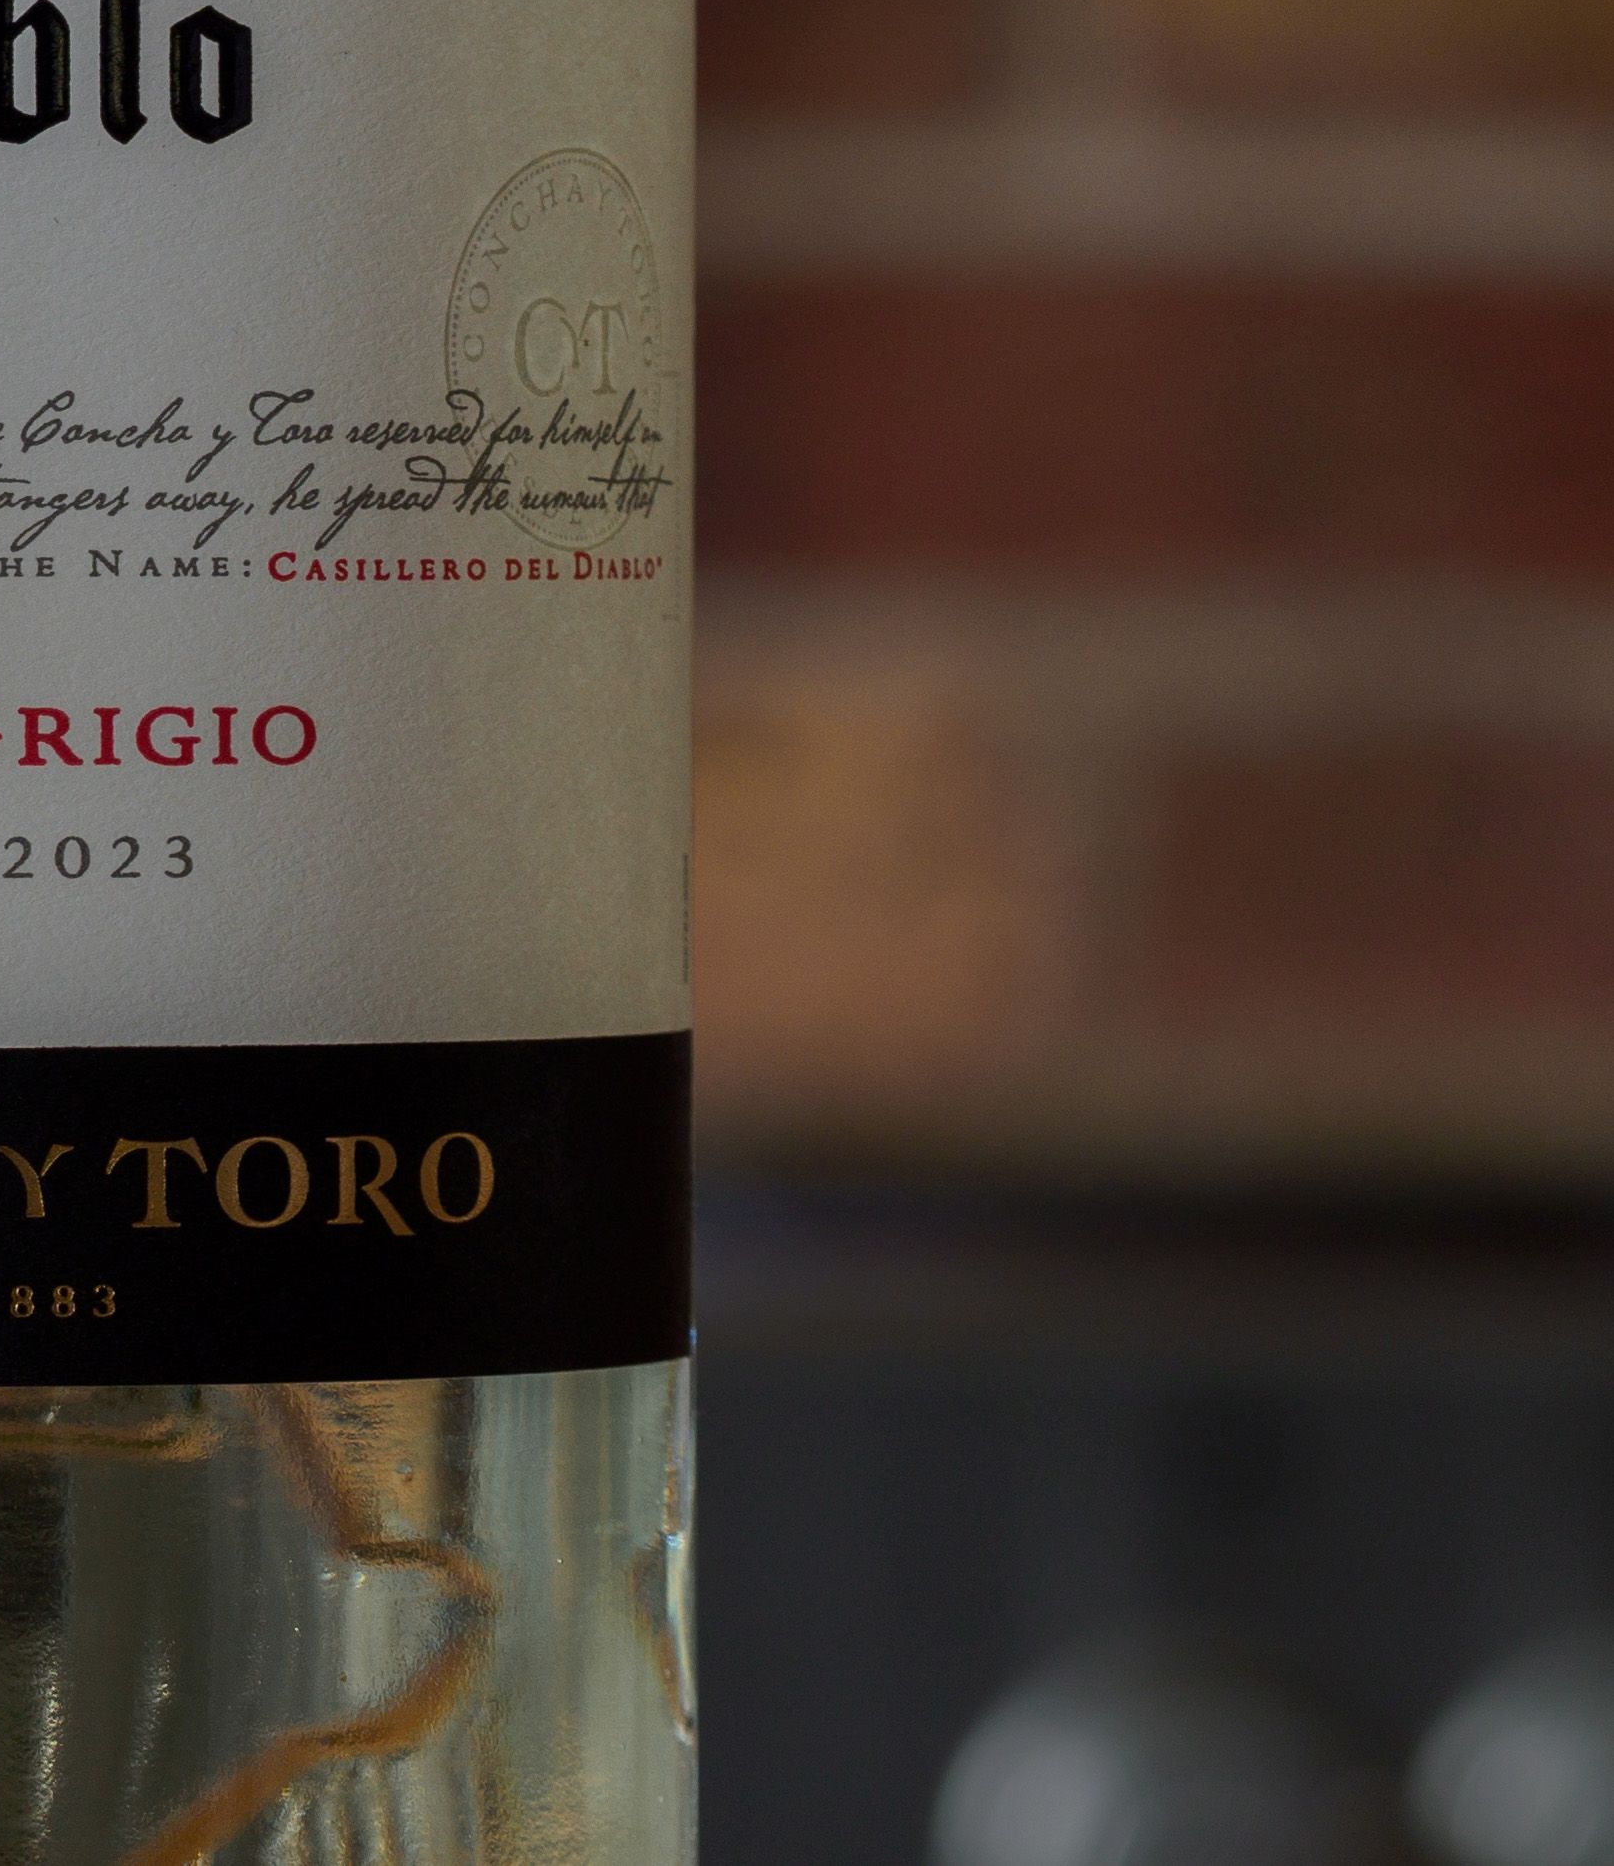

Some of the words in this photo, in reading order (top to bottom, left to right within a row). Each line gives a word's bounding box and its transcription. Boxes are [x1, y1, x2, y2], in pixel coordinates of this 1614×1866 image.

[20, 390, 192, 454] Concha
[184, 423, 237, 484] y
[249, 387, 334, 447] Toro
[345, 389, 485, 451] reserved
[474, 406, 534, 476] for
[539, 388, 643, 491] himself
[144, 486, 255, 551] away,
[269, 462, 321, 516] he
[314, 455, 447, 552] spread
[588, 462, 673, 519] that
[267, 551, 487, 583] CASILLERO
[105, 1131, 495, 1236] TORO
